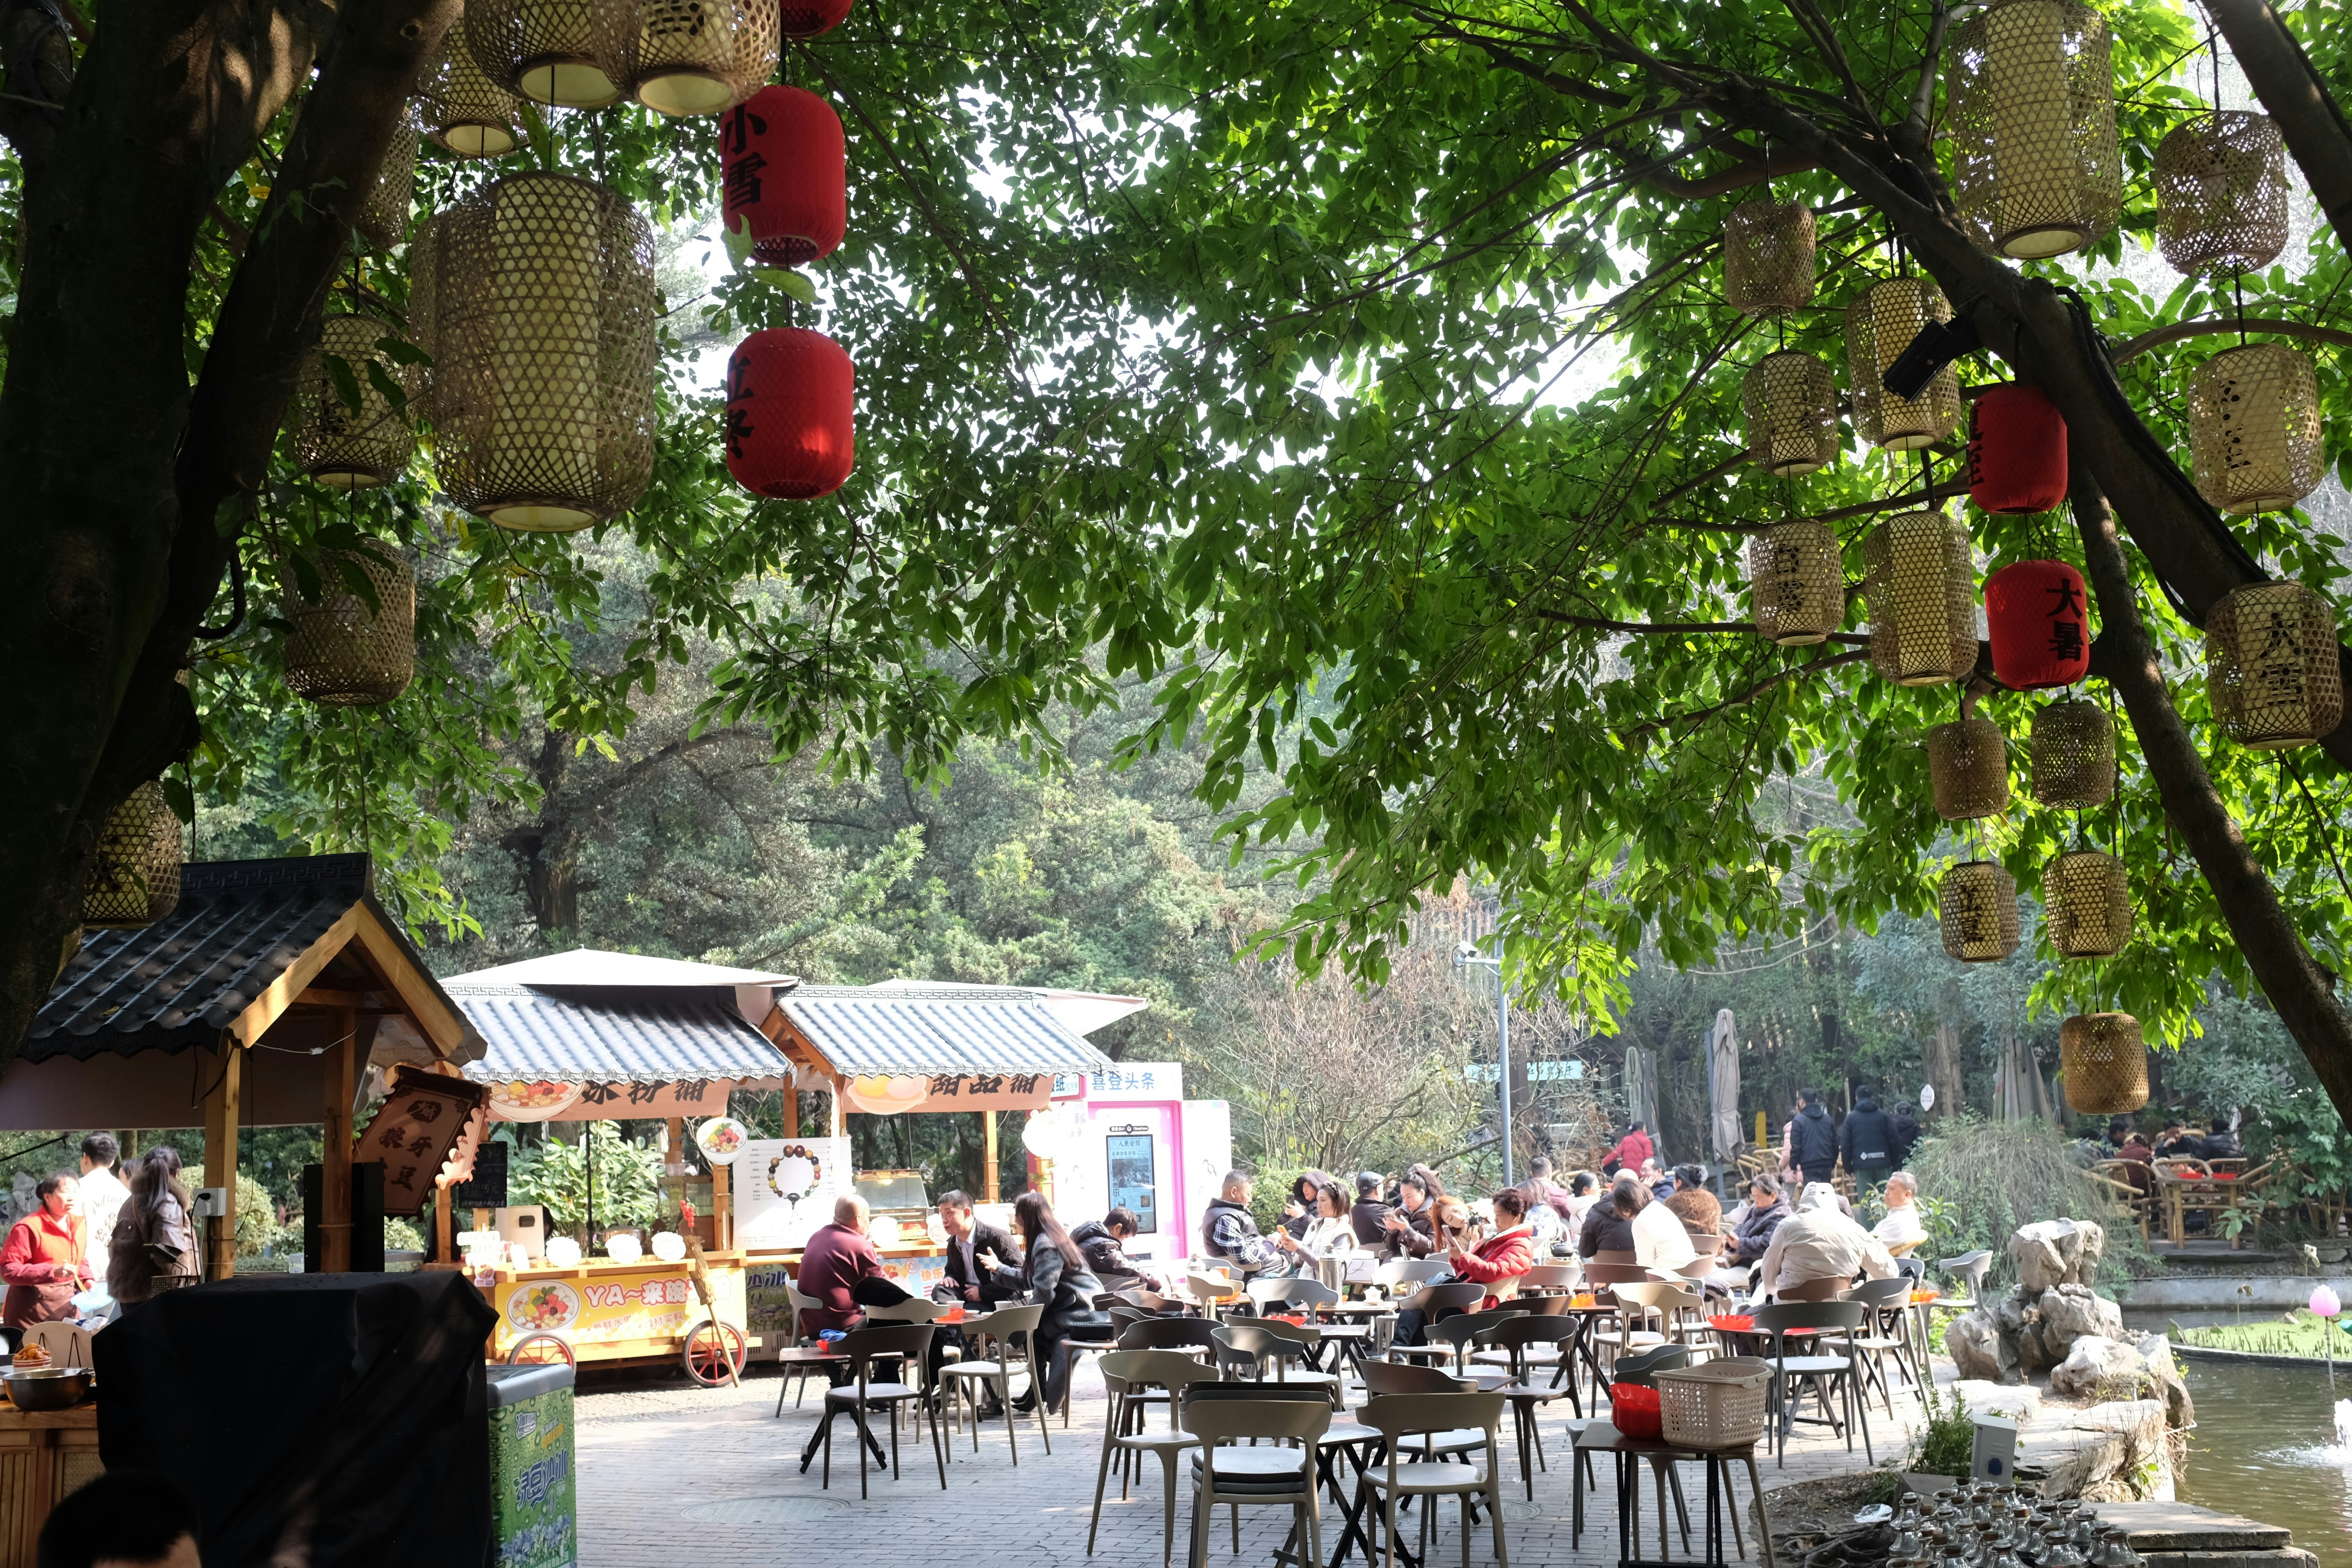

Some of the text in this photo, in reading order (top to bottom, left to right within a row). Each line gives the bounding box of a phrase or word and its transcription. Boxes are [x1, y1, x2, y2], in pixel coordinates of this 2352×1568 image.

[724, 104, 767, 211] 小雪
[2046, 578, 2084, 662] 大暑
[1092, 1072, 1154, 1090] 喜登头条
[379, 1127, 432, 1158] 狼牙
[921, 1268, 943, 1281] 快乐
